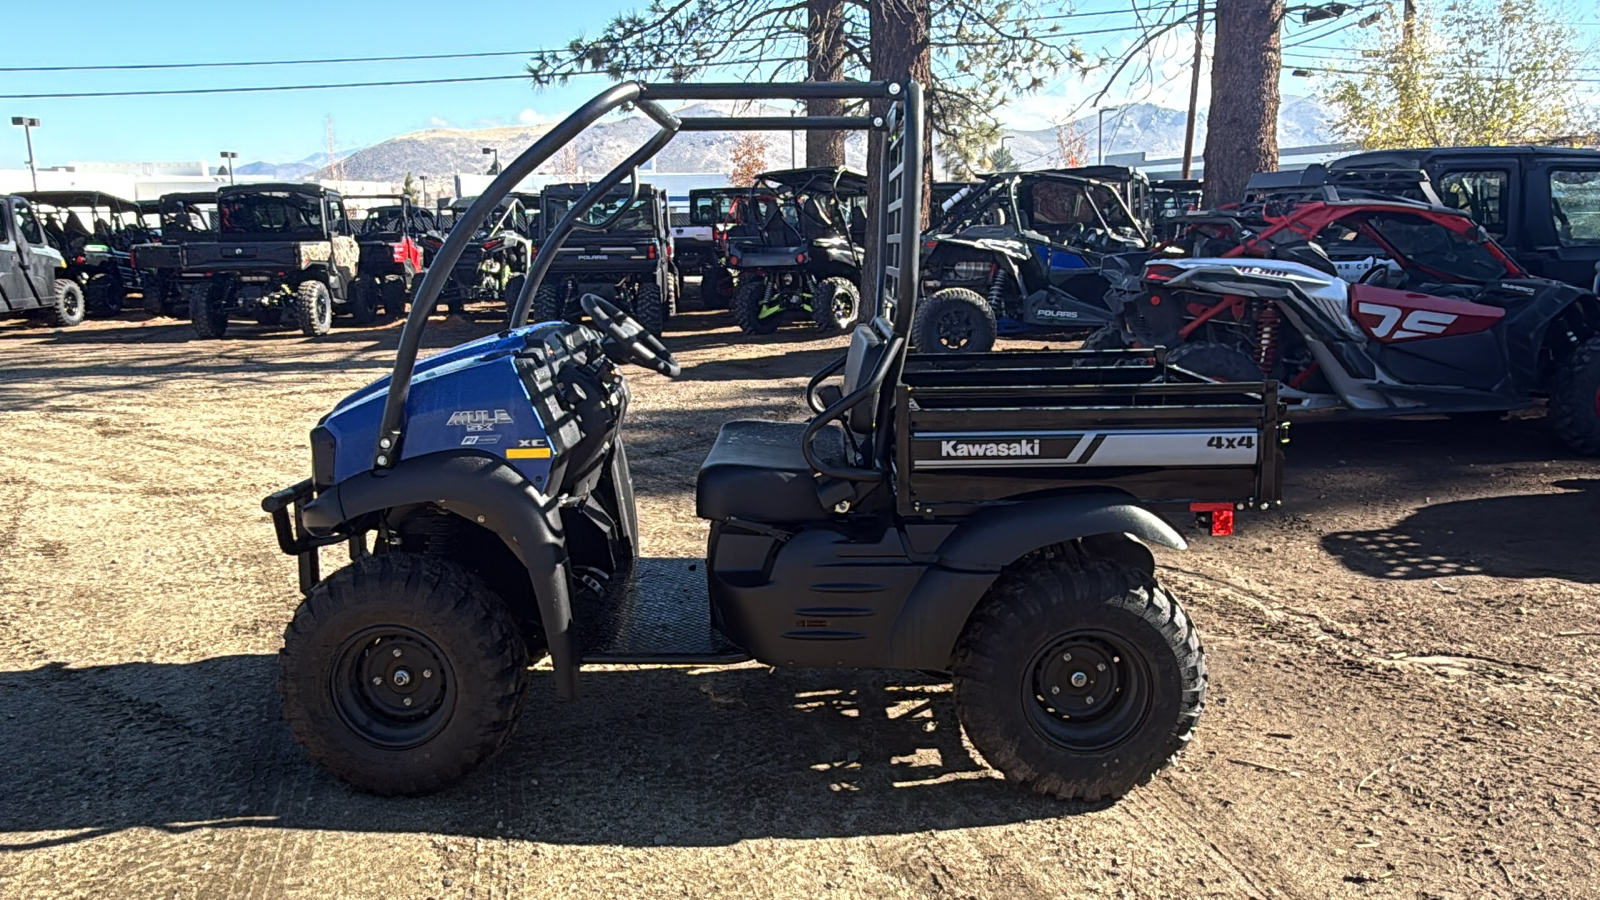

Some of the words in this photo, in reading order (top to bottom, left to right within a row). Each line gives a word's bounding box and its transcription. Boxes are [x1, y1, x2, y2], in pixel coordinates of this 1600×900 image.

[1037, 309, 1078, 318] POLARIS
[446, 409, 514, 426] MULE
[518, 439, 547, 448] XC
[941, 439, 1040, 457] Kawasaki
[1206, 435, 1255, 449] 4x4
